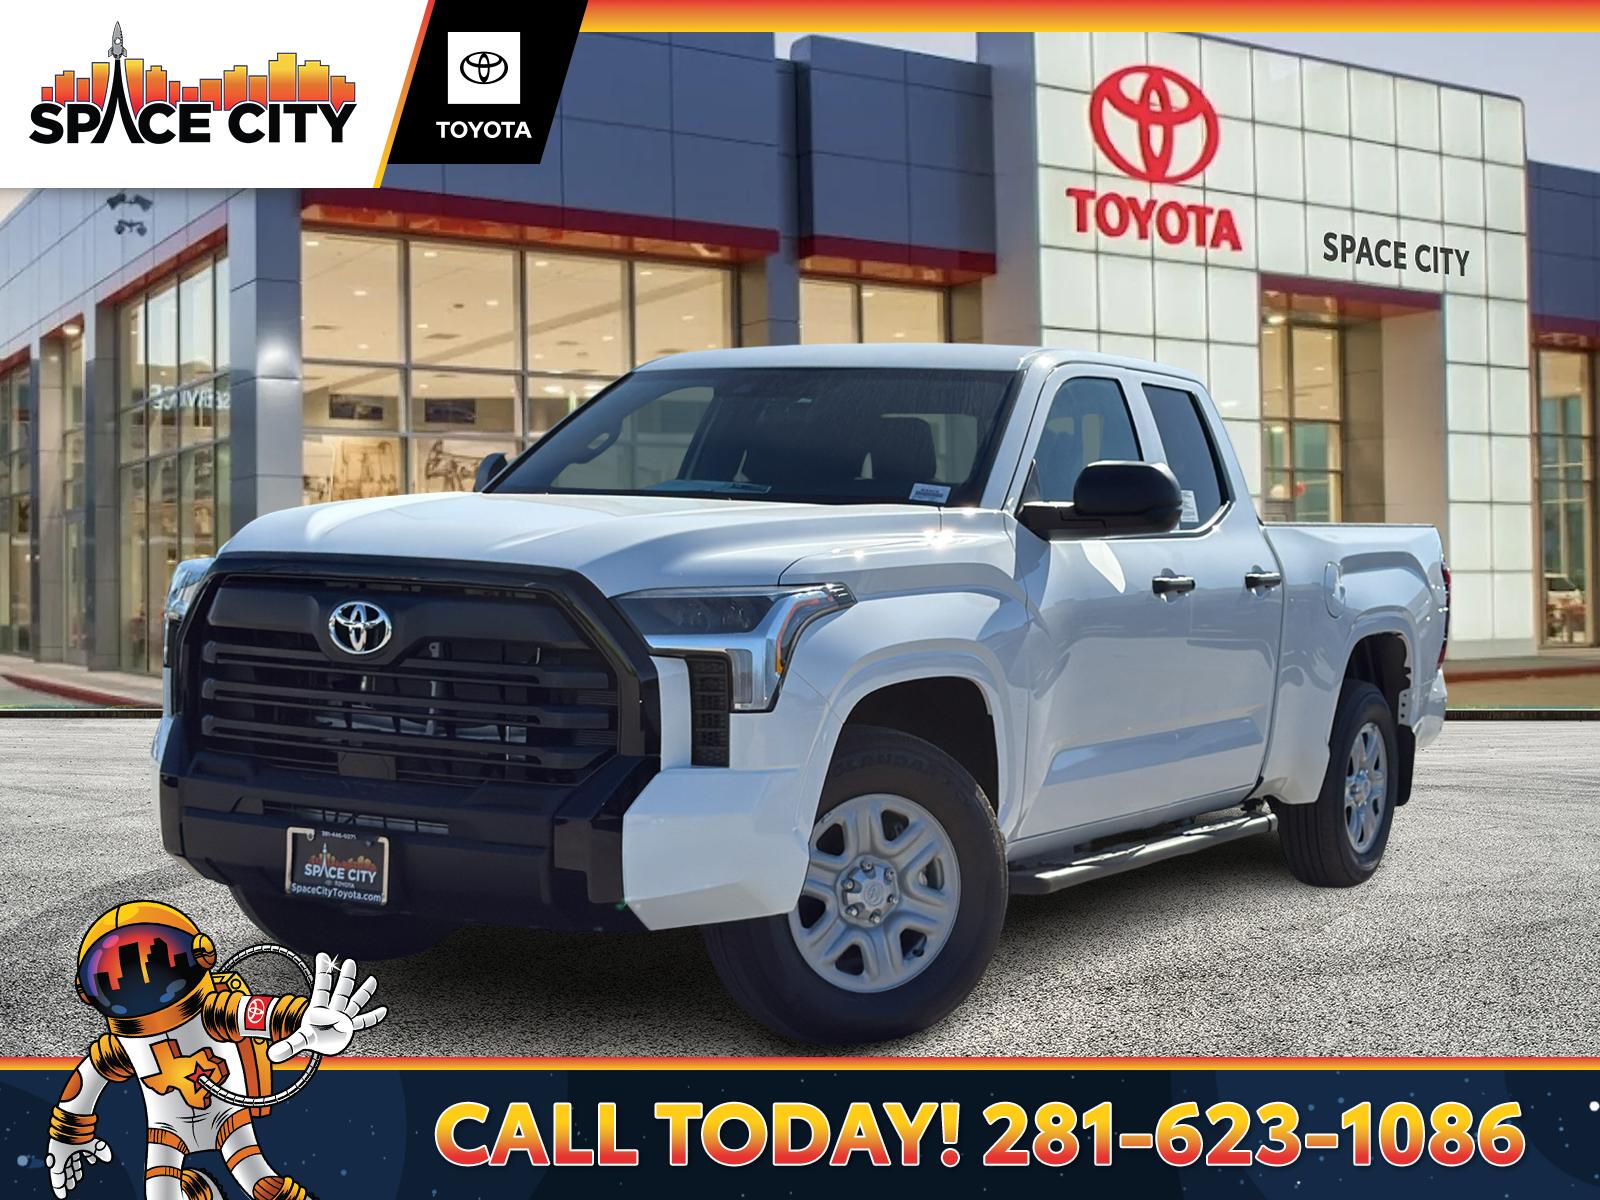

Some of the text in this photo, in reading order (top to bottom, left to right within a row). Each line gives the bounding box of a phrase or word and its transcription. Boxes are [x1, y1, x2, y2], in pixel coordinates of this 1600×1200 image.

[1066, 188, 1242, 251] TOYOTA
[1323, 232, 1470, 277] SPACE CITY
[304, 854, 377, 883] SPACE CITY
[291, 883, 382, 902] SpaceCityToyota.com
